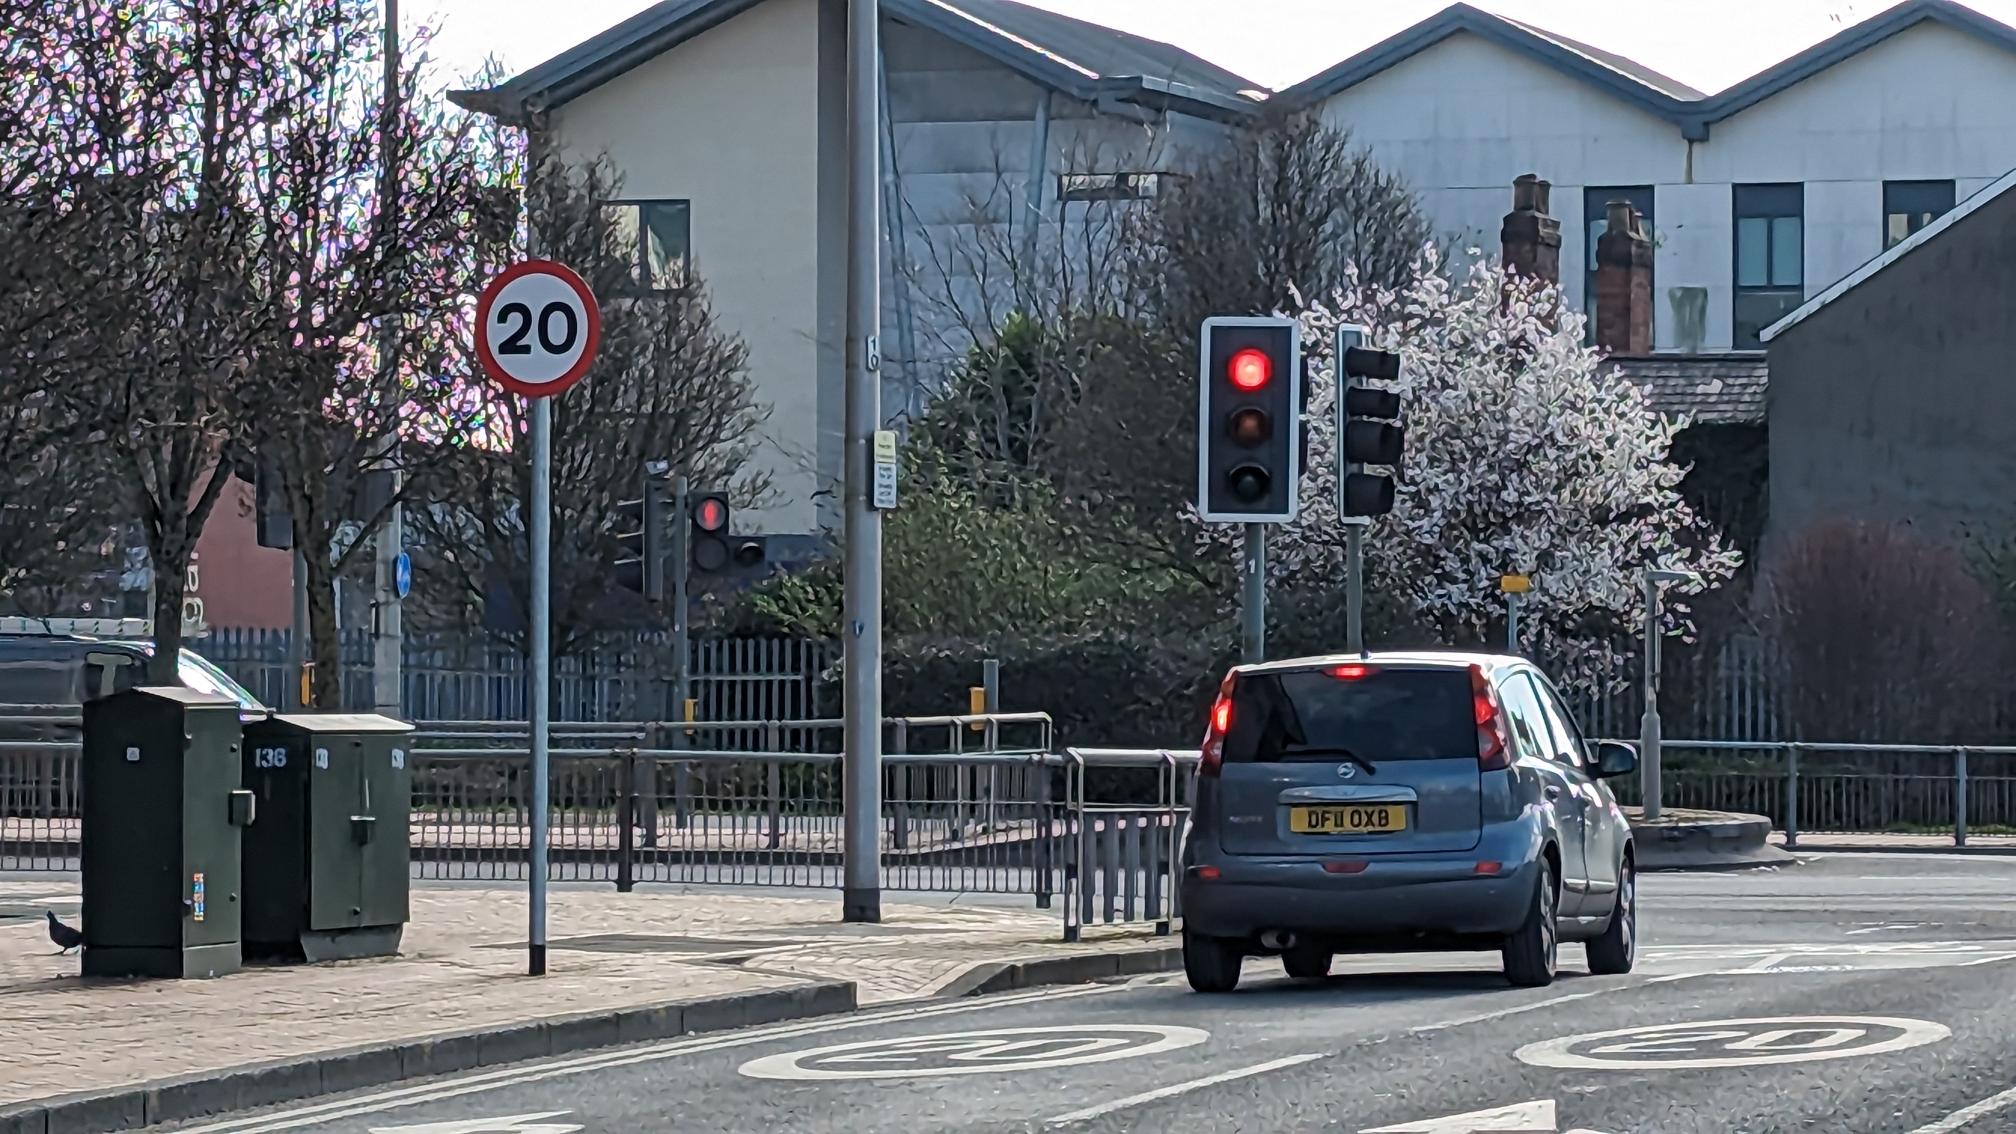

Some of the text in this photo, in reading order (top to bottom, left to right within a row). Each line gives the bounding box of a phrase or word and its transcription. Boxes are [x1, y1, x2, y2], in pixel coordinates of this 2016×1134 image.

[497, 301, 578, 355] 20
[255, 748, 287, 768] 136
[1307, 809, 1390, 828] DF11 OXB
[815, 1038, 1130, 1063] 20
[1588, 1029, 1867, 1053] 20
